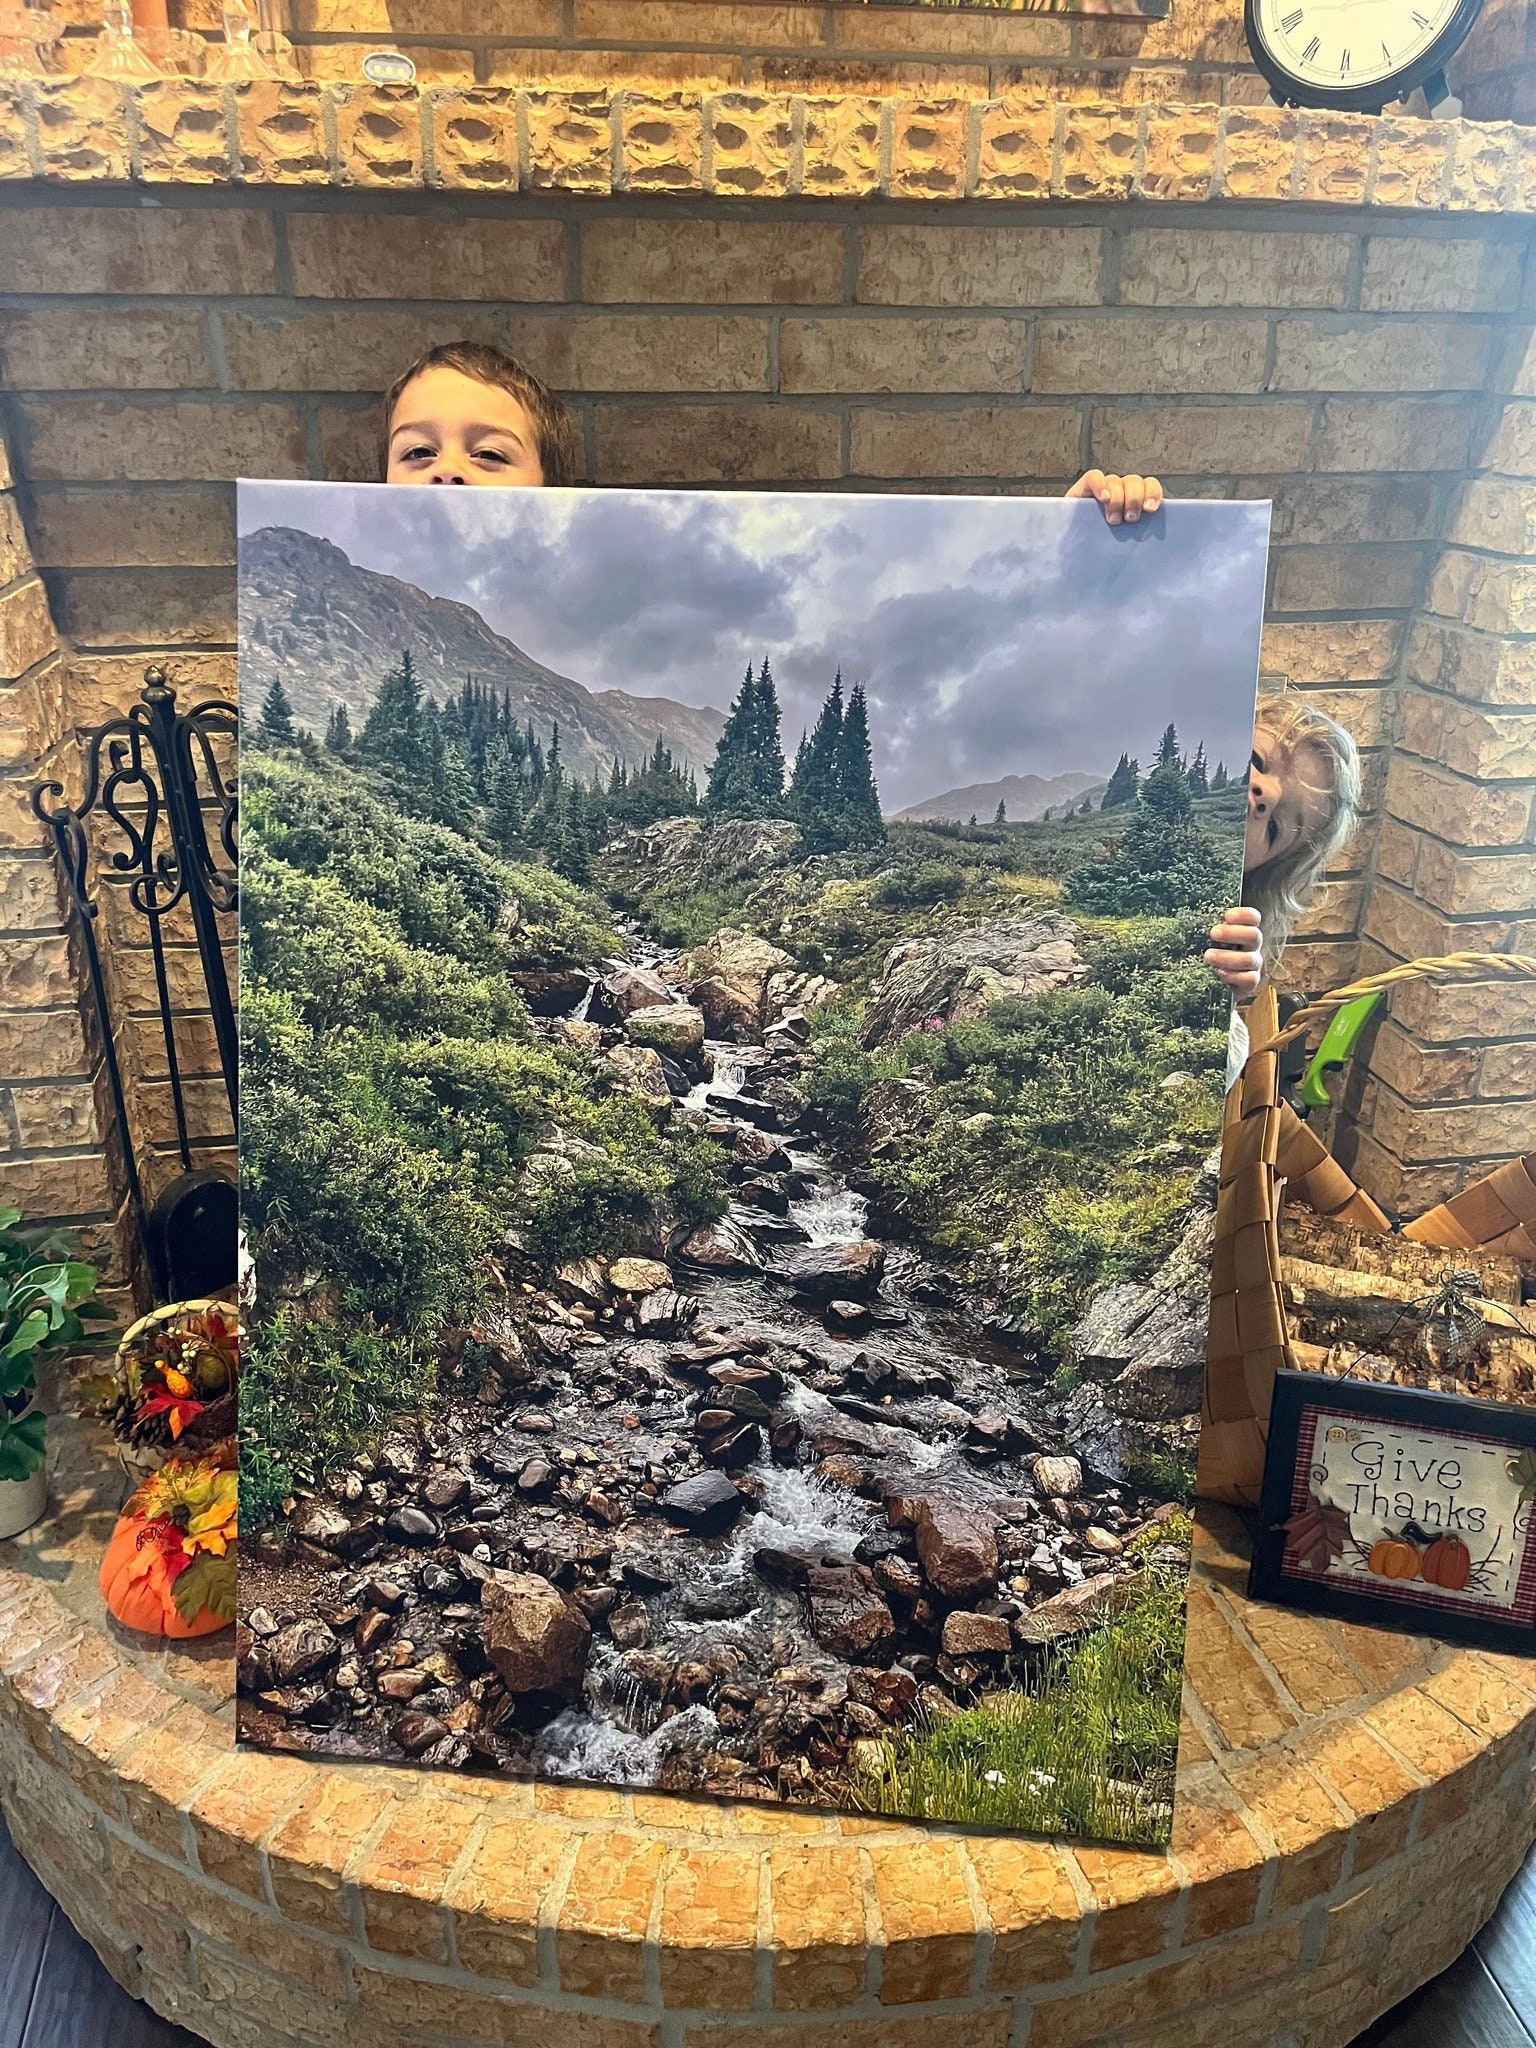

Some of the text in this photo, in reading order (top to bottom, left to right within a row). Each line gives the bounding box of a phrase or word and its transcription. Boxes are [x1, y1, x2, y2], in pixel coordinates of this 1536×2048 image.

[1281, 8, 1303, 34] VIII
[1302, 36, 1321, 61] VII
[1340, 49, 1350, 71] VI
[1381, 40, 1391, 60] V
[1351, 1441, 1462, 1489] Give
[1346, 1483, 1487, 1532] Thanks
